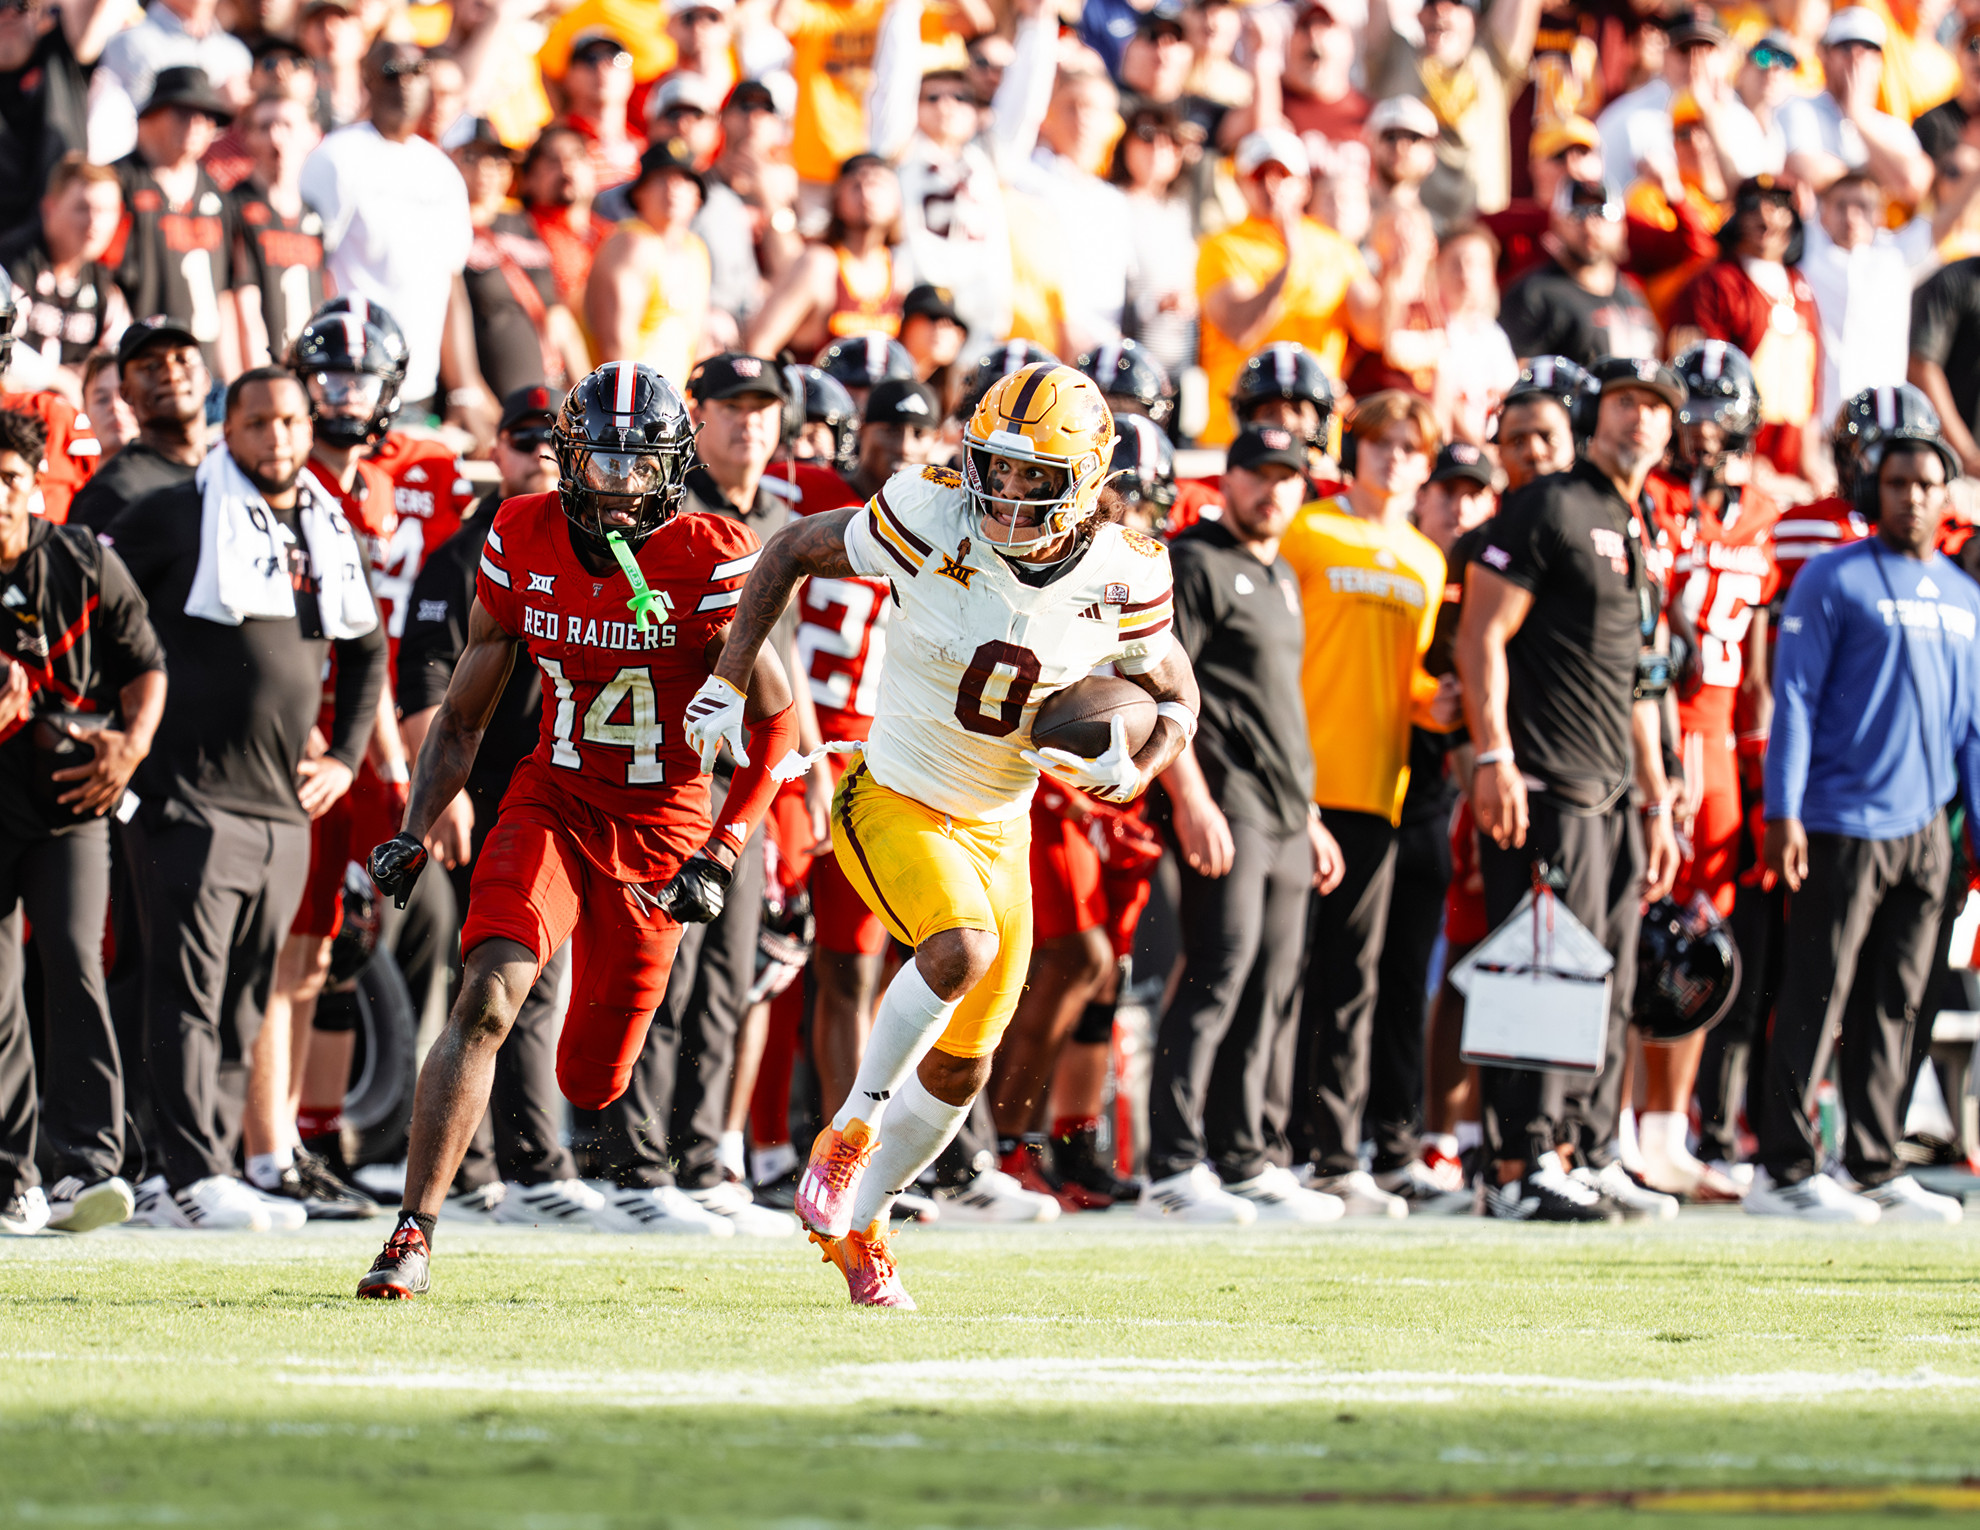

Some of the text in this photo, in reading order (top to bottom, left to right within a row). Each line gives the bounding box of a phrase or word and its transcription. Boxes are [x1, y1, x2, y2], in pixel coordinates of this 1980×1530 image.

[527, 571, 556, 596] XII
[936, 556, 974, 588] XII
[524, 605, 677, 650] RED RAIDERS
[954, 639, 1042, 738] 0
[536, 653, 666, 785] 14
